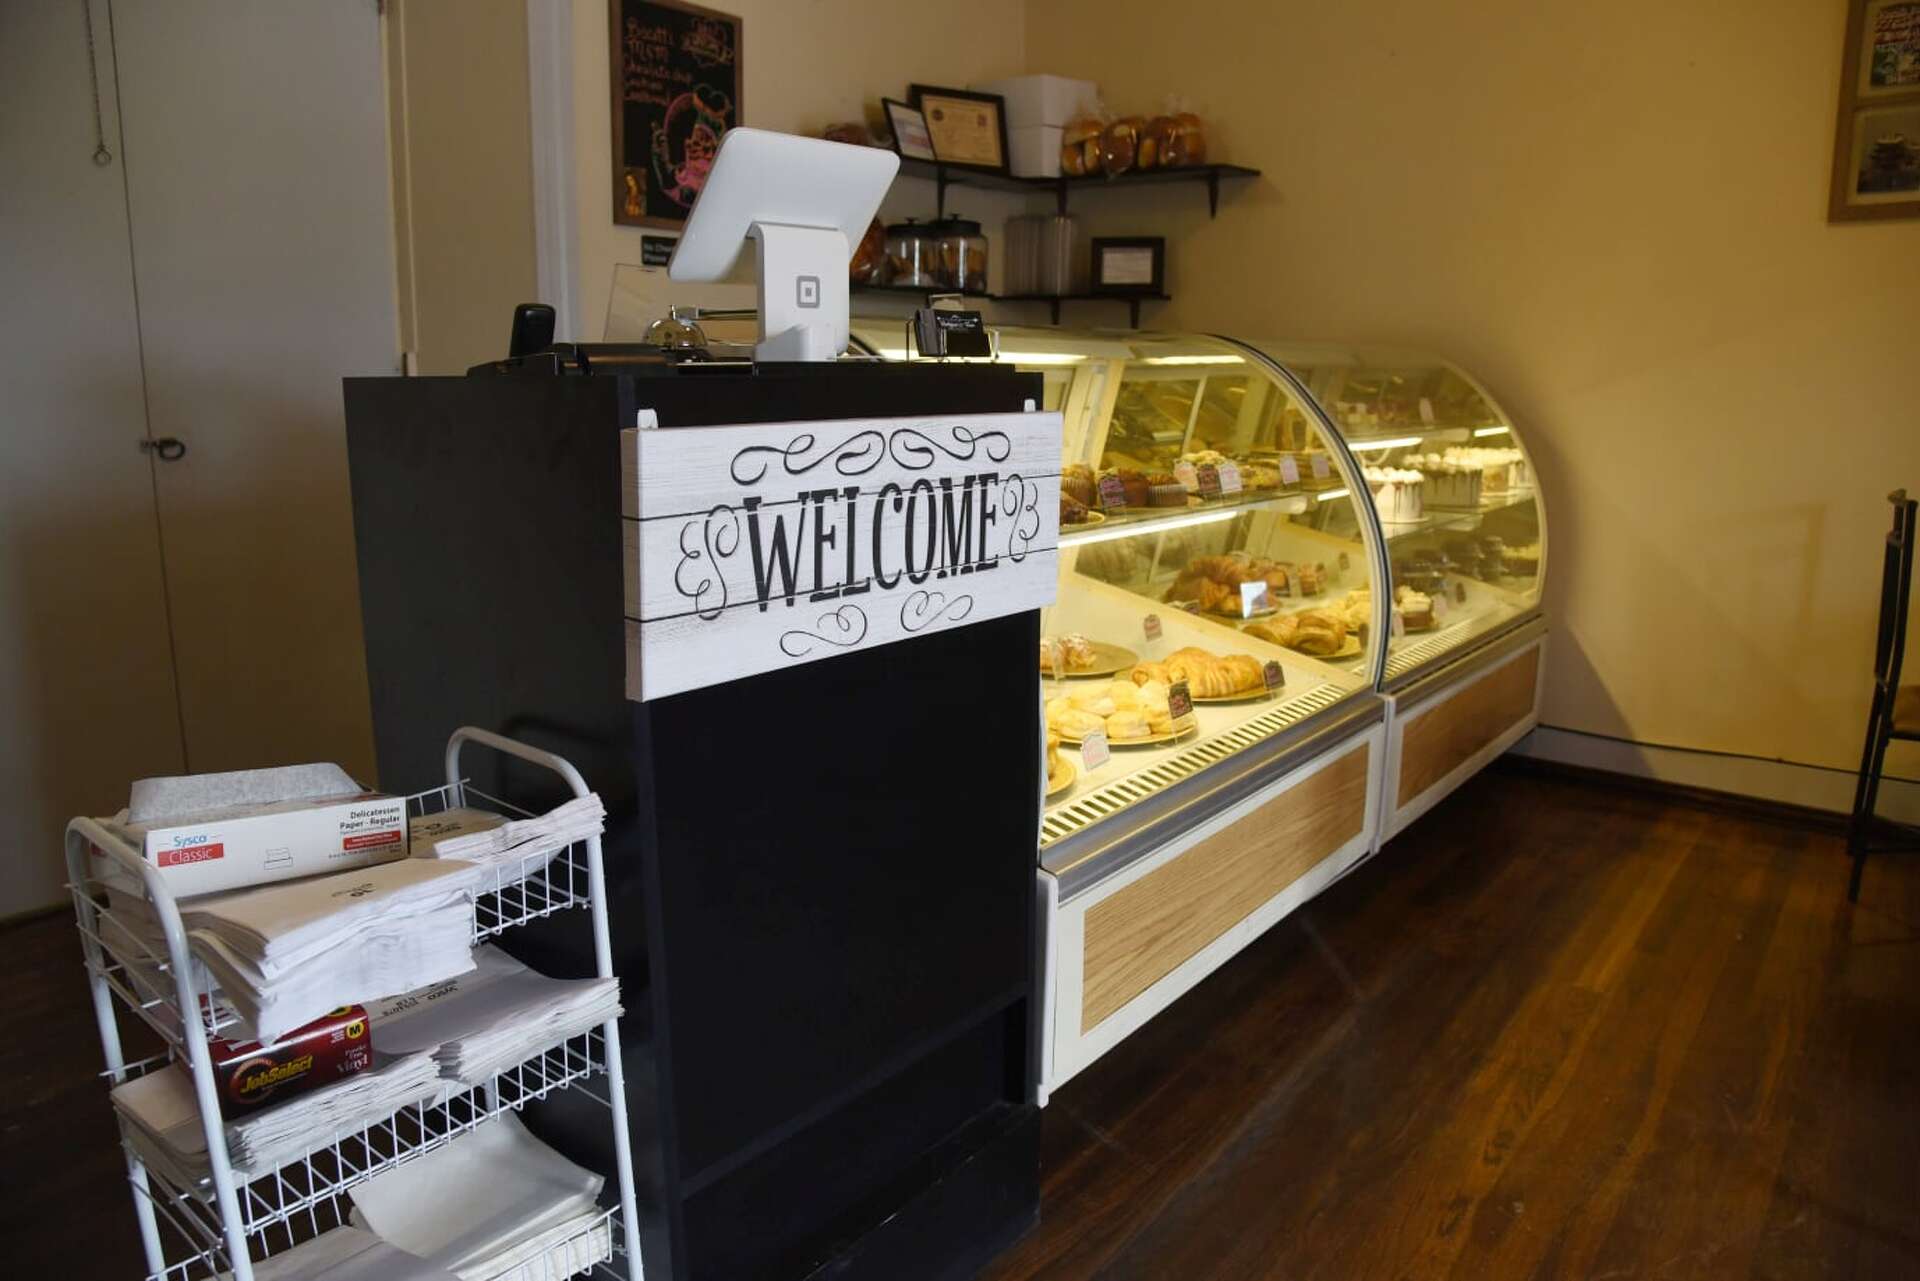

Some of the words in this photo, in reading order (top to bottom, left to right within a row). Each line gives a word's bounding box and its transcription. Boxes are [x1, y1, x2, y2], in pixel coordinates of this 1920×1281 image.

[743, 473, 998, 612] WELCOME
[350, 807, 400, 819] Delicatessen
[340, 820, 363, 830] Paper
[370, 815, 400, 826] Regular
[173, 835, 208, 848] Sysco
[169, 847, 213, 864] Classic
[241, 1056, 313, 1093] JobSelect
